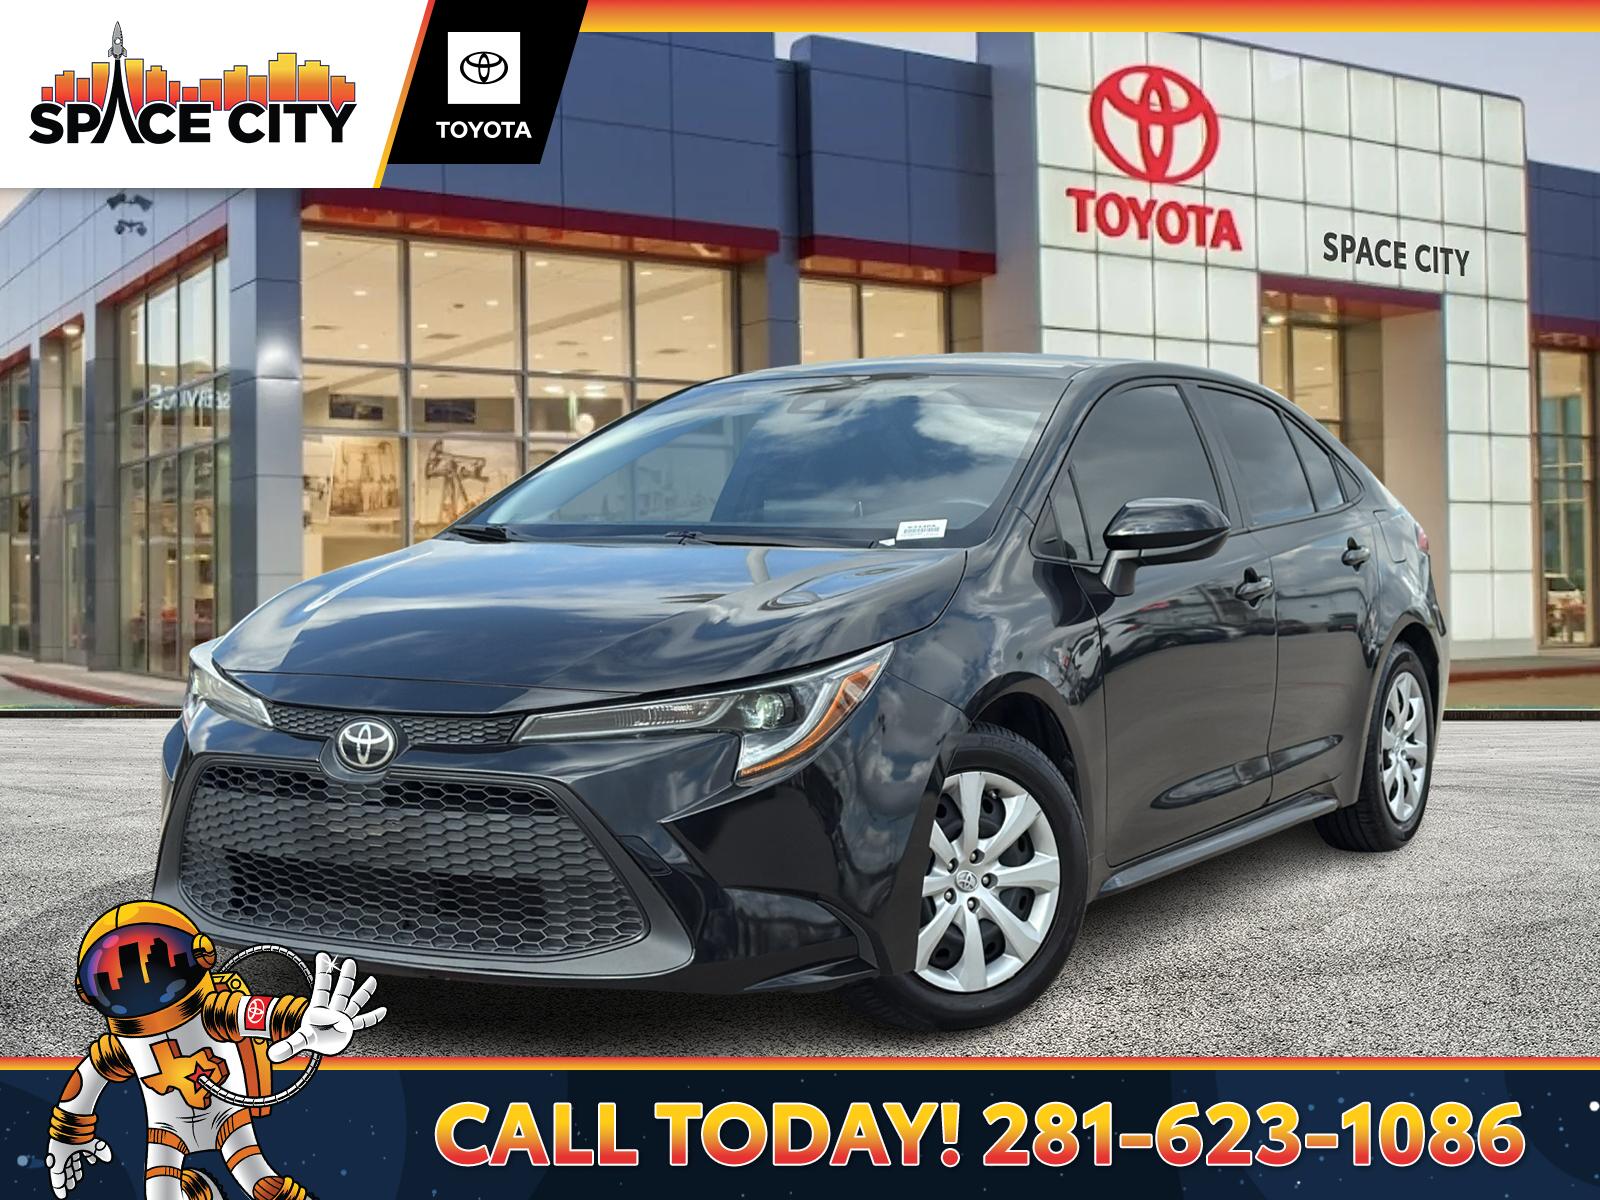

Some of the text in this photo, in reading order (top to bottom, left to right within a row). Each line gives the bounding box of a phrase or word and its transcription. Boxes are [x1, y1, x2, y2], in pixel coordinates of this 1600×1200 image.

[1066, 187, 1243, 251] TOYOTA
[1323, 232, 1470, 277] SPACE CITY
